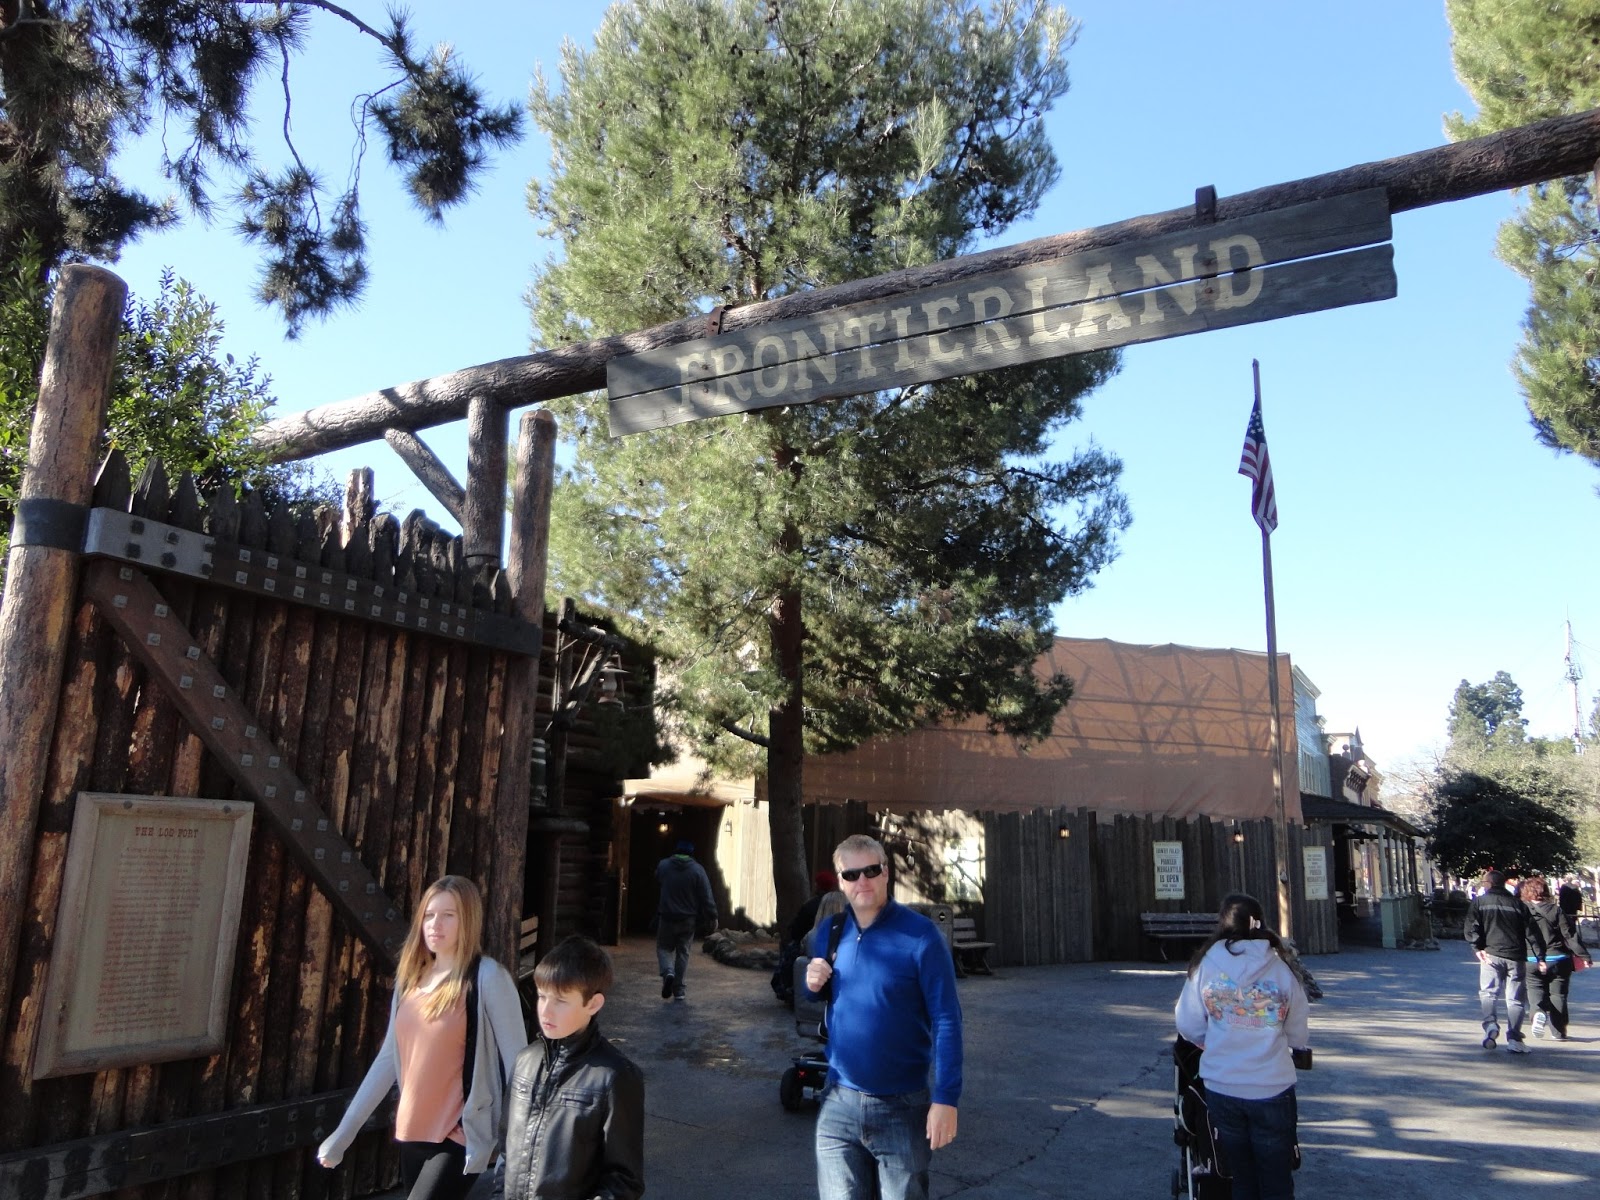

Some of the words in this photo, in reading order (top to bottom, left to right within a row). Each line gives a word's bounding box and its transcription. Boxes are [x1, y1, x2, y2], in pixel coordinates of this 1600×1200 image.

[675, 233, 1267, 413] FRONTIERLAND
[135, 827, 154, 837] THE
[158, 828, 175, 838] LOG
[177, 829, 199, 839] FORT
[1159, 875, 1165, 883] IS
[1166, 874, 1179, 883] OPEN
